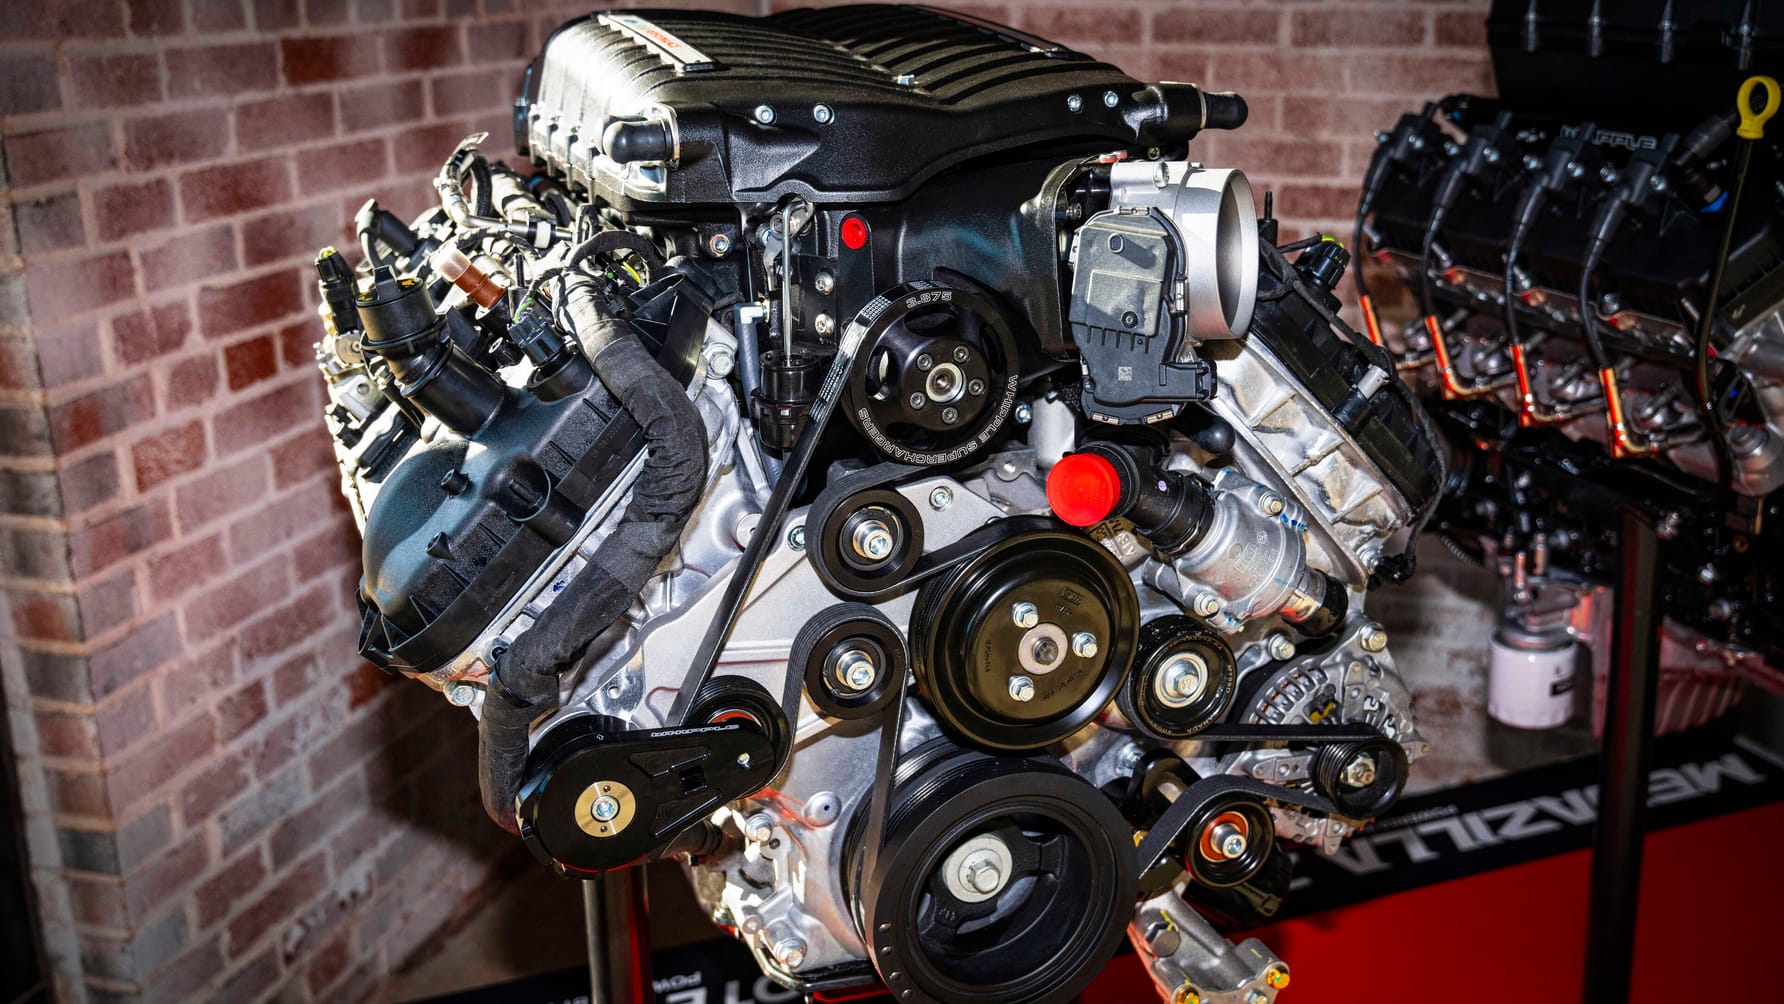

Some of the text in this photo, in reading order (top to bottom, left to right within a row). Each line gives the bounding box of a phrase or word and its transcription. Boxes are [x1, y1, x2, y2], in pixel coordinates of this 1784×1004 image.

[906, 291, 953, 308] 3.875
[858, 374, 1019, 465] WHIPPLE SUPERCHARGERS
[1322, 753, 1767, 875] MEAZILLA
